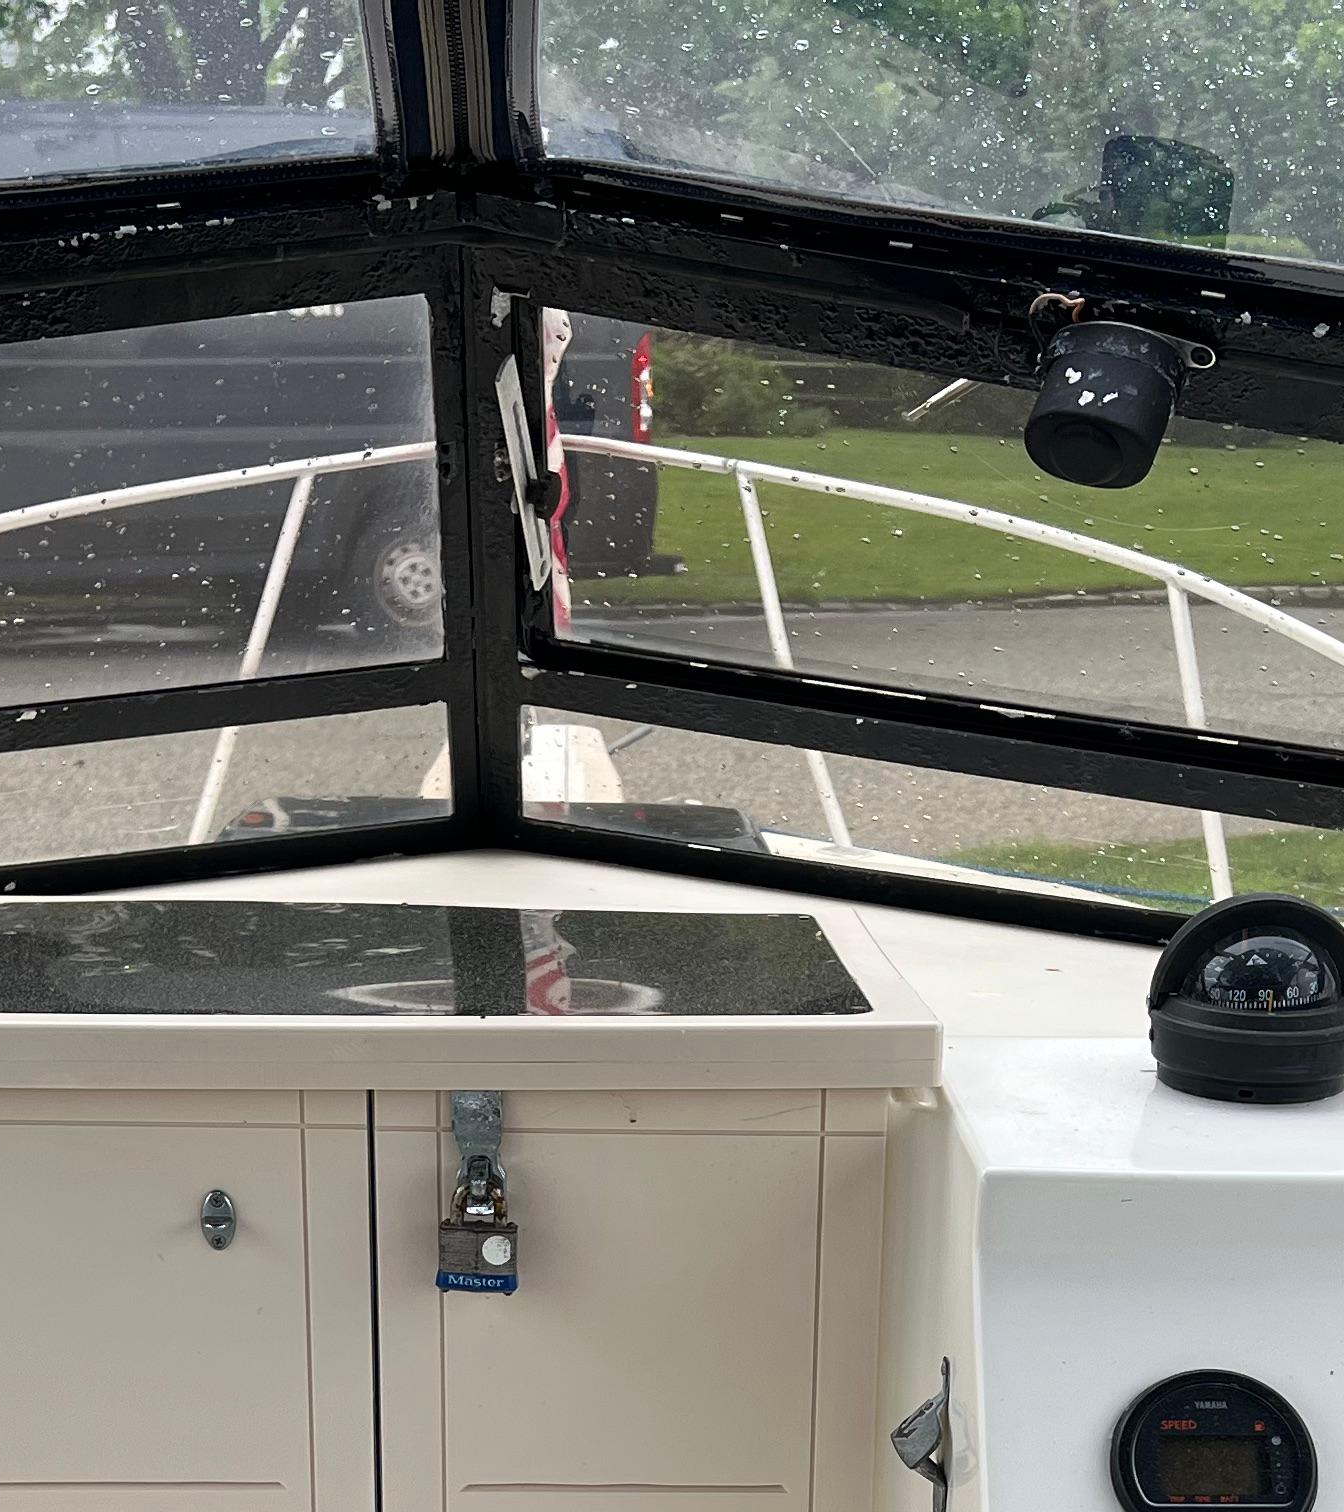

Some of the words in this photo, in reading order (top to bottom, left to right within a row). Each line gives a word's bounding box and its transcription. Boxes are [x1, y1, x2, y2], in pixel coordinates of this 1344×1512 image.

[1229, 989, 1247, 1002] 120
[1258, 989, 1271, 1001] 90
[1286, 986, 1299, 999] 60
[1194, 1401, 1228, 1409] YAMAHA
[1160, 1420, 1198, 1430] SPEED
